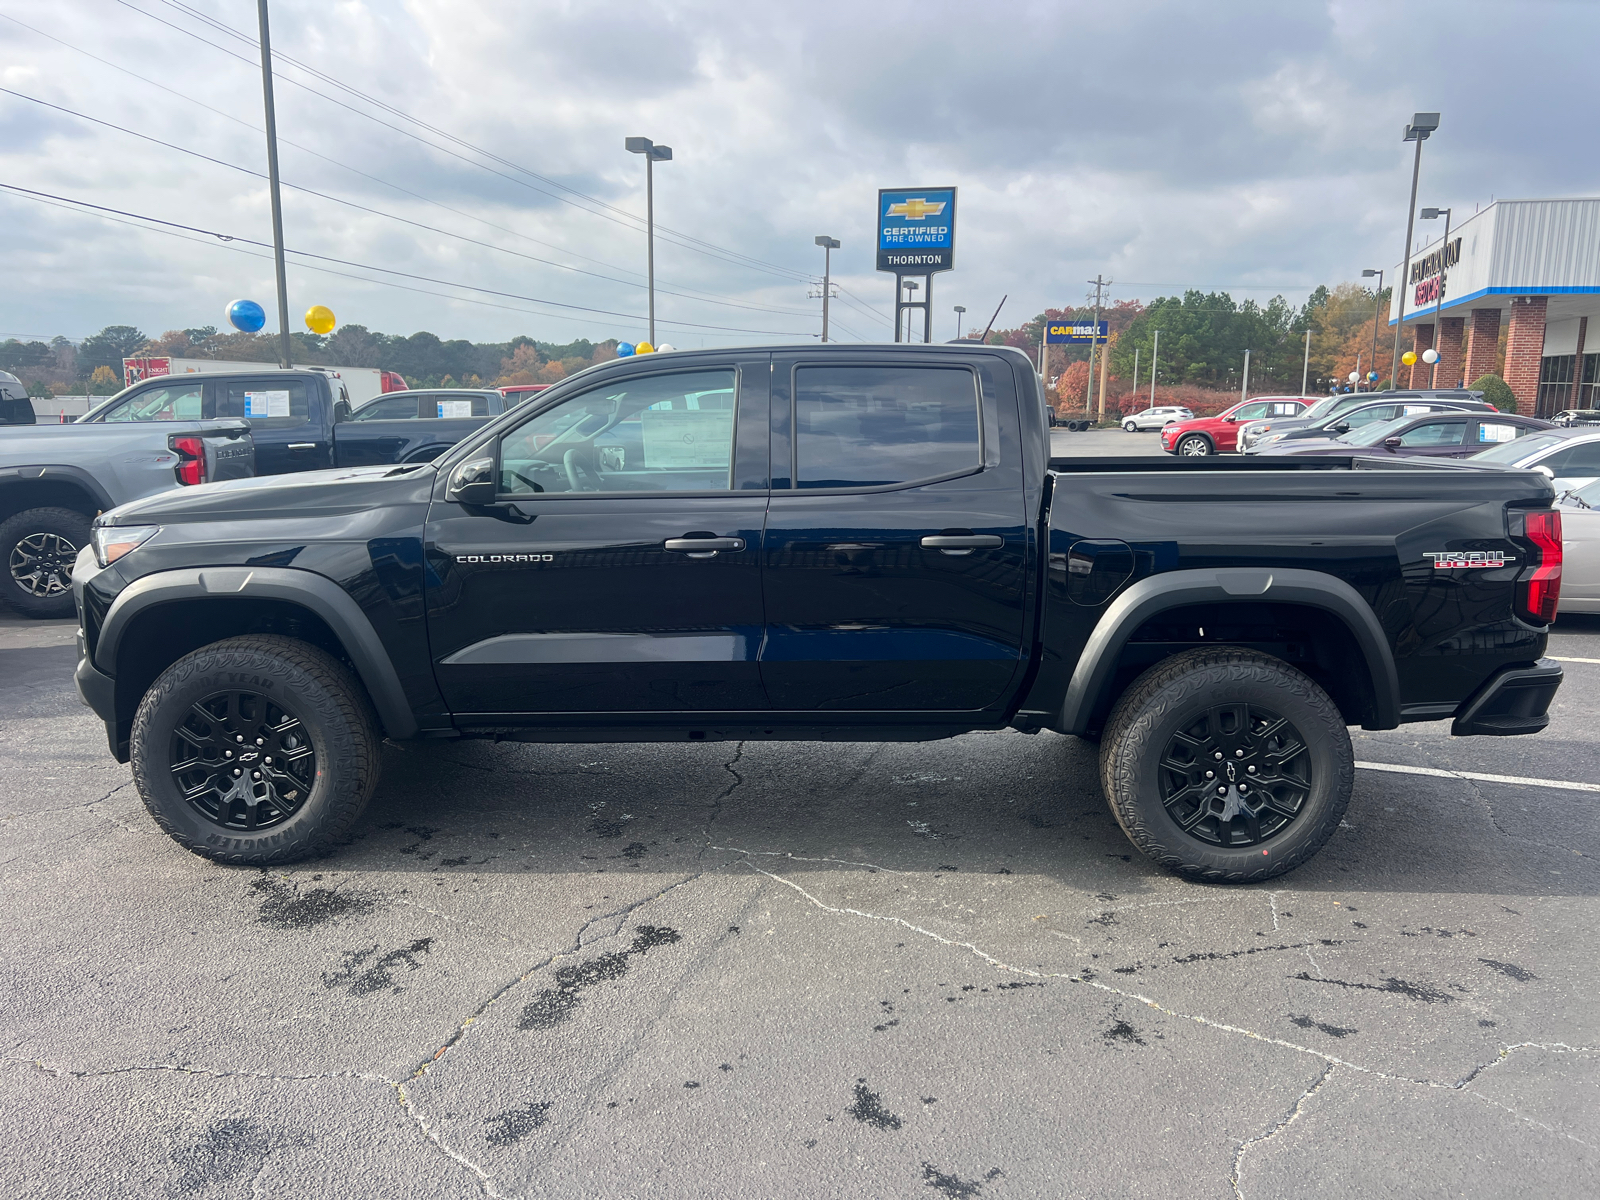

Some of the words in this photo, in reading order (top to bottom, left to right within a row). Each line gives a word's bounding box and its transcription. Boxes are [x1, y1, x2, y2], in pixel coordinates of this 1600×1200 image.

[883, 227, 948, 235] CERTIFIED
[886, 235, 944, 243] PRE-OWNED
[888, 255, 942, 265] THORNTON
[456, 554, 554, 563] COLORADO
[1423, 551, 1516, 561] TRAIL
[1434, 560, 1504, 569] BOSS
